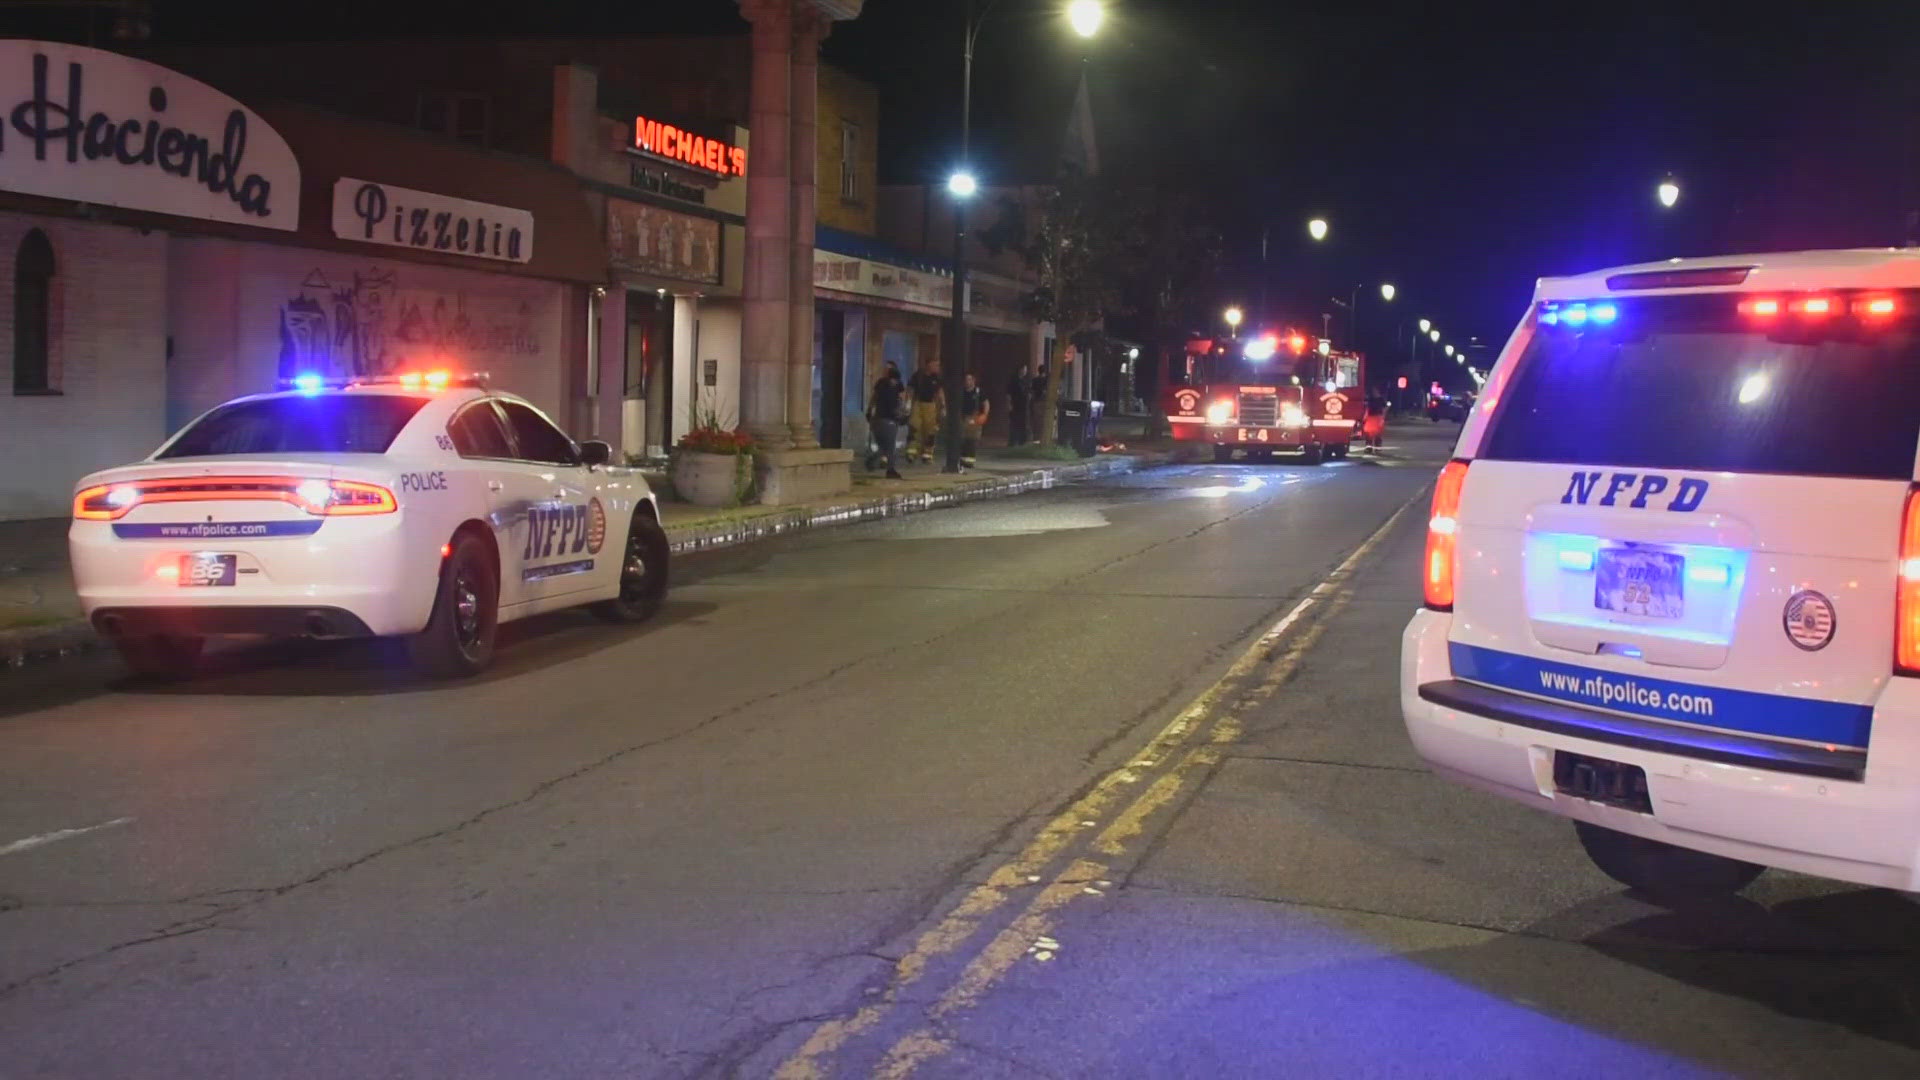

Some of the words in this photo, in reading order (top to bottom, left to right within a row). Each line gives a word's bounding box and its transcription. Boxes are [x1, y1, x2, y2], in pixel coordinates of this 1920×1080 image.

[10, 53, 272, 217] Hacienda
[635, 115, 745, 177] MICHAEL'S
[354, 183, 522, 259] Pizzeria
[401, 471, 448, 492] POLICE
[1560, 471, 1710, 512] NFPD
[160, 524, 267, 537] www.nfpolice.com
[524, 504, 588, 560] NFPD
[192, 562, 226, 580] 86
[1539, 669, 1713, 716] www.nfpolice.com
